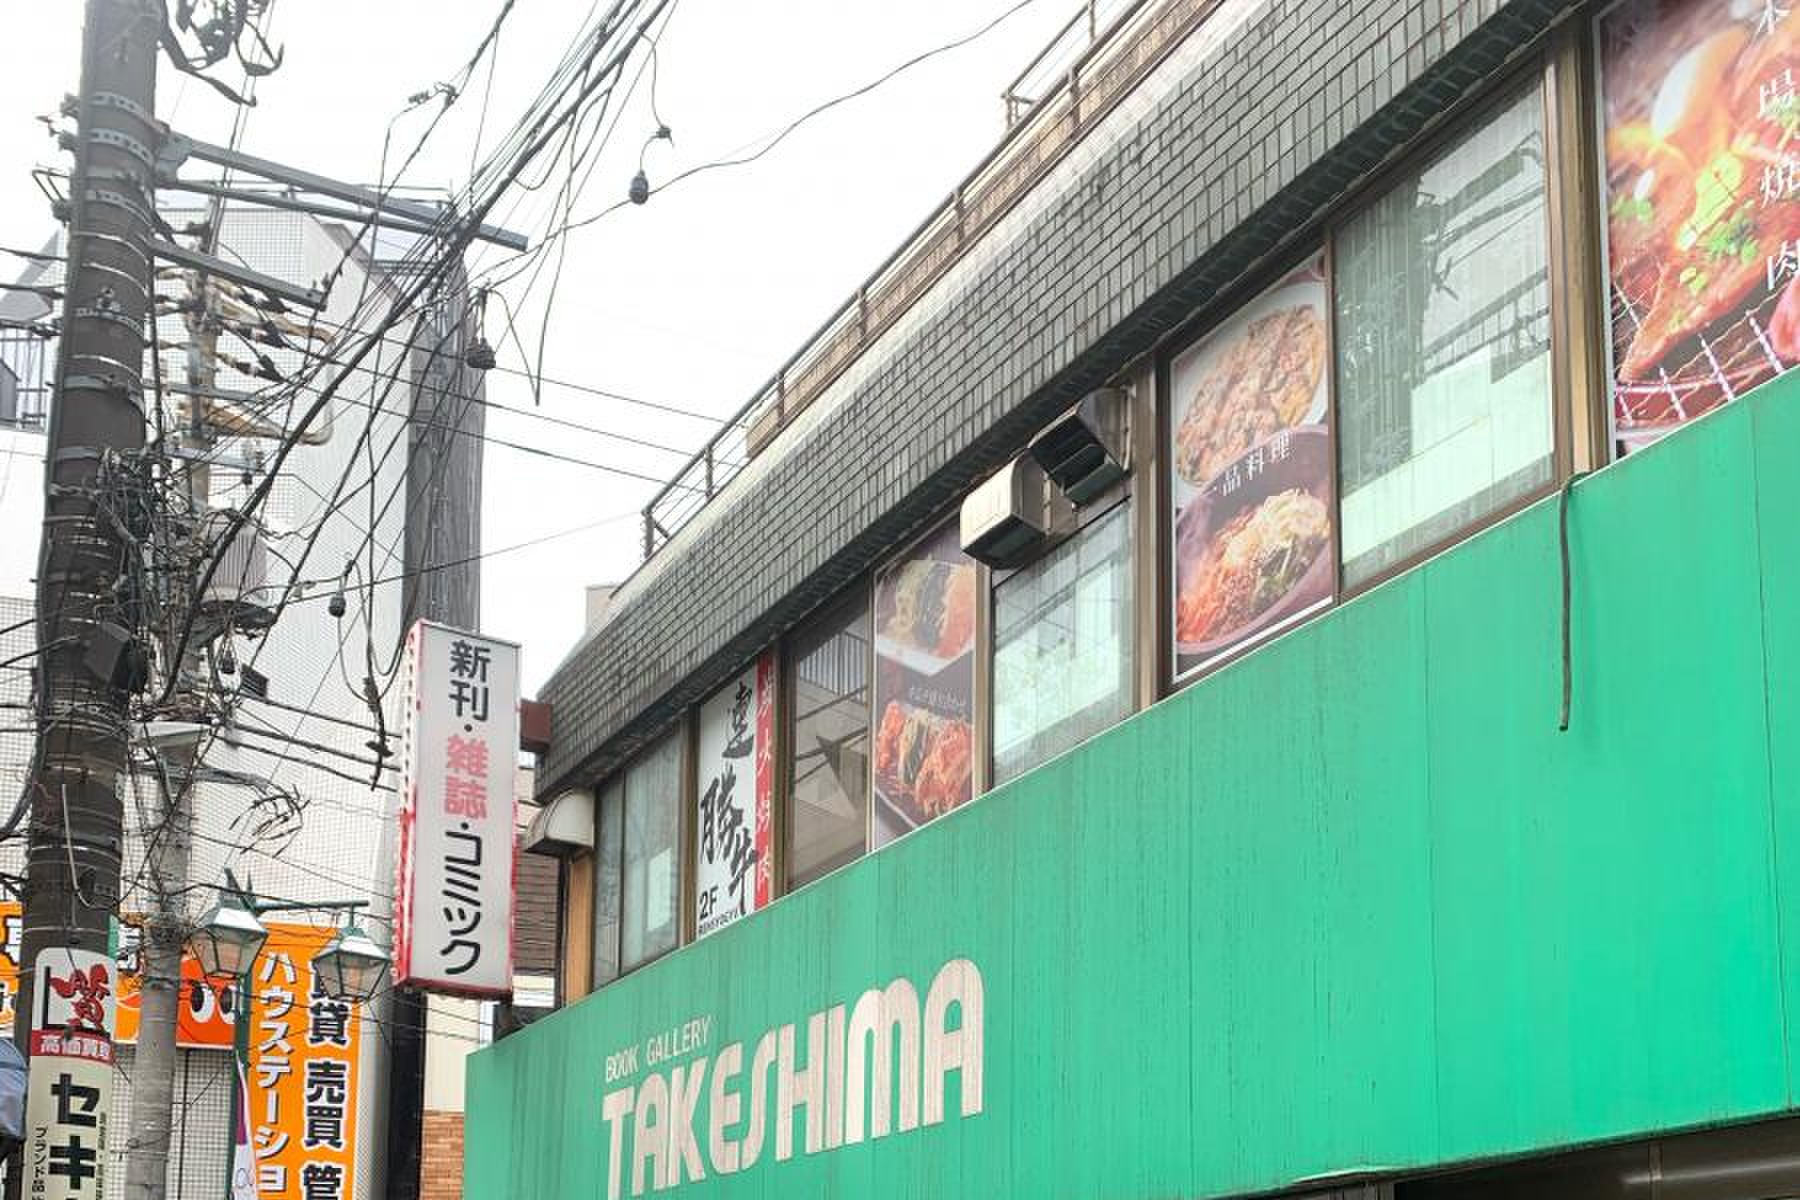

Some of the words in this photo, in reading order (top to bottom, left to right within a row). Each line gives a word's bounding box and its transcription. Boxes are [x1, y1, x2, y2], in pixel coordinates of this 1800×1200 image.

[440, 638, 492, 976] 新刊・雑誌・コミック
[700, 886, 719, 921] 2F
[605, 1043, 640, 1082] BOOK
[646, 1014, 713, 1067] GALLERY
[304, 1061, 350, 1148] 売買
